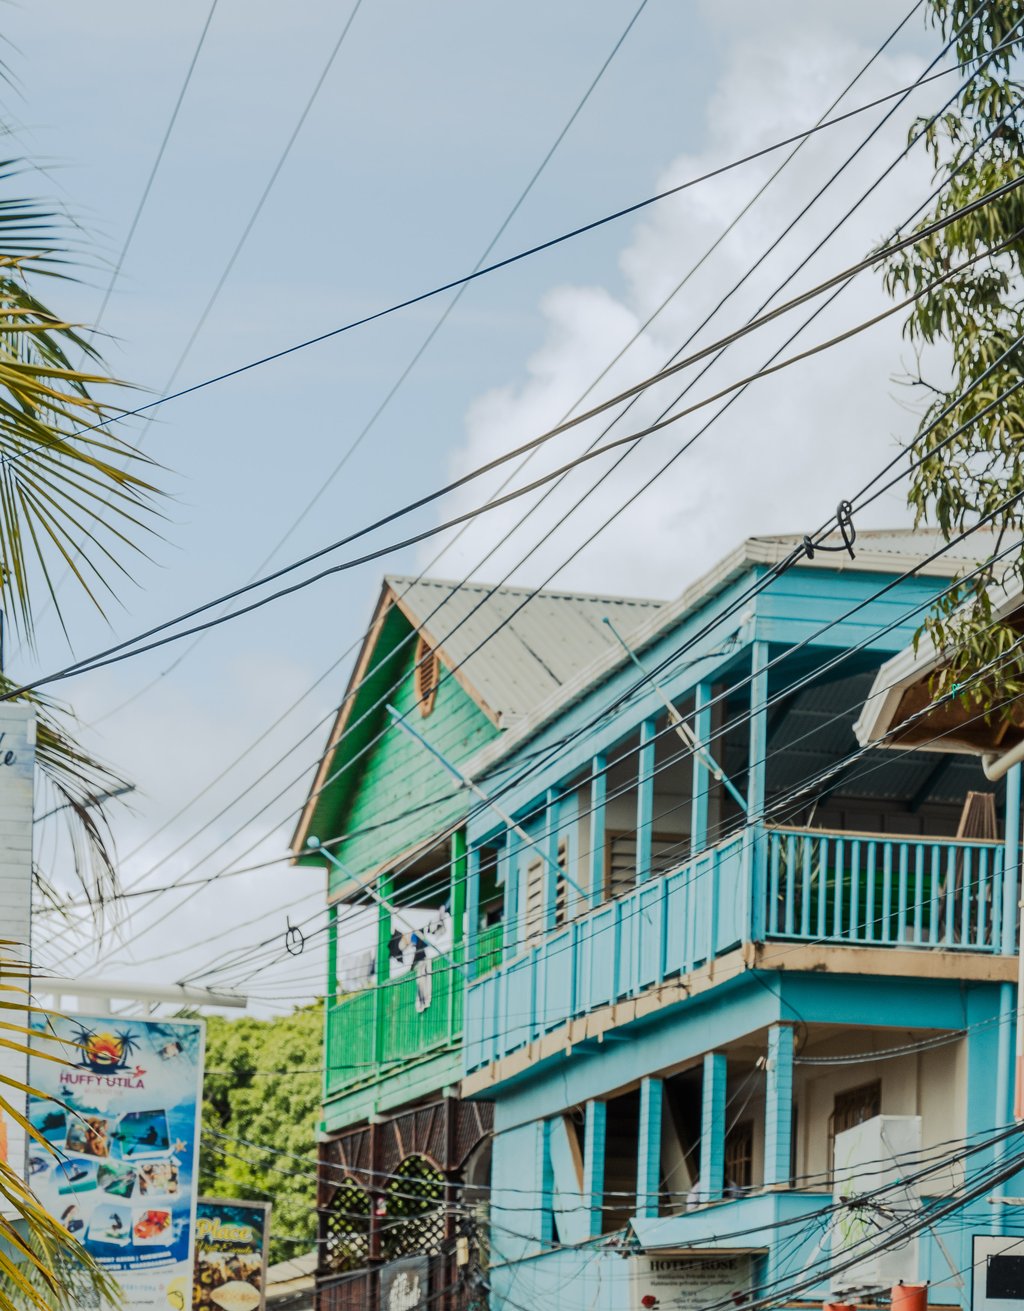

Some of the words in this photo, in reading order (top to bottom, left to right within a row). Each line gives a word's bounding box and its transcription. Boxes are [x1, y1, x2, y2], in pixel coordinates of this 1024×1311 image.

[59, 1072, 103, 1087] HUFFY
[105, 1075, 145, 1089] UTILA
[701, 1258, 738, 1271] ROSE
